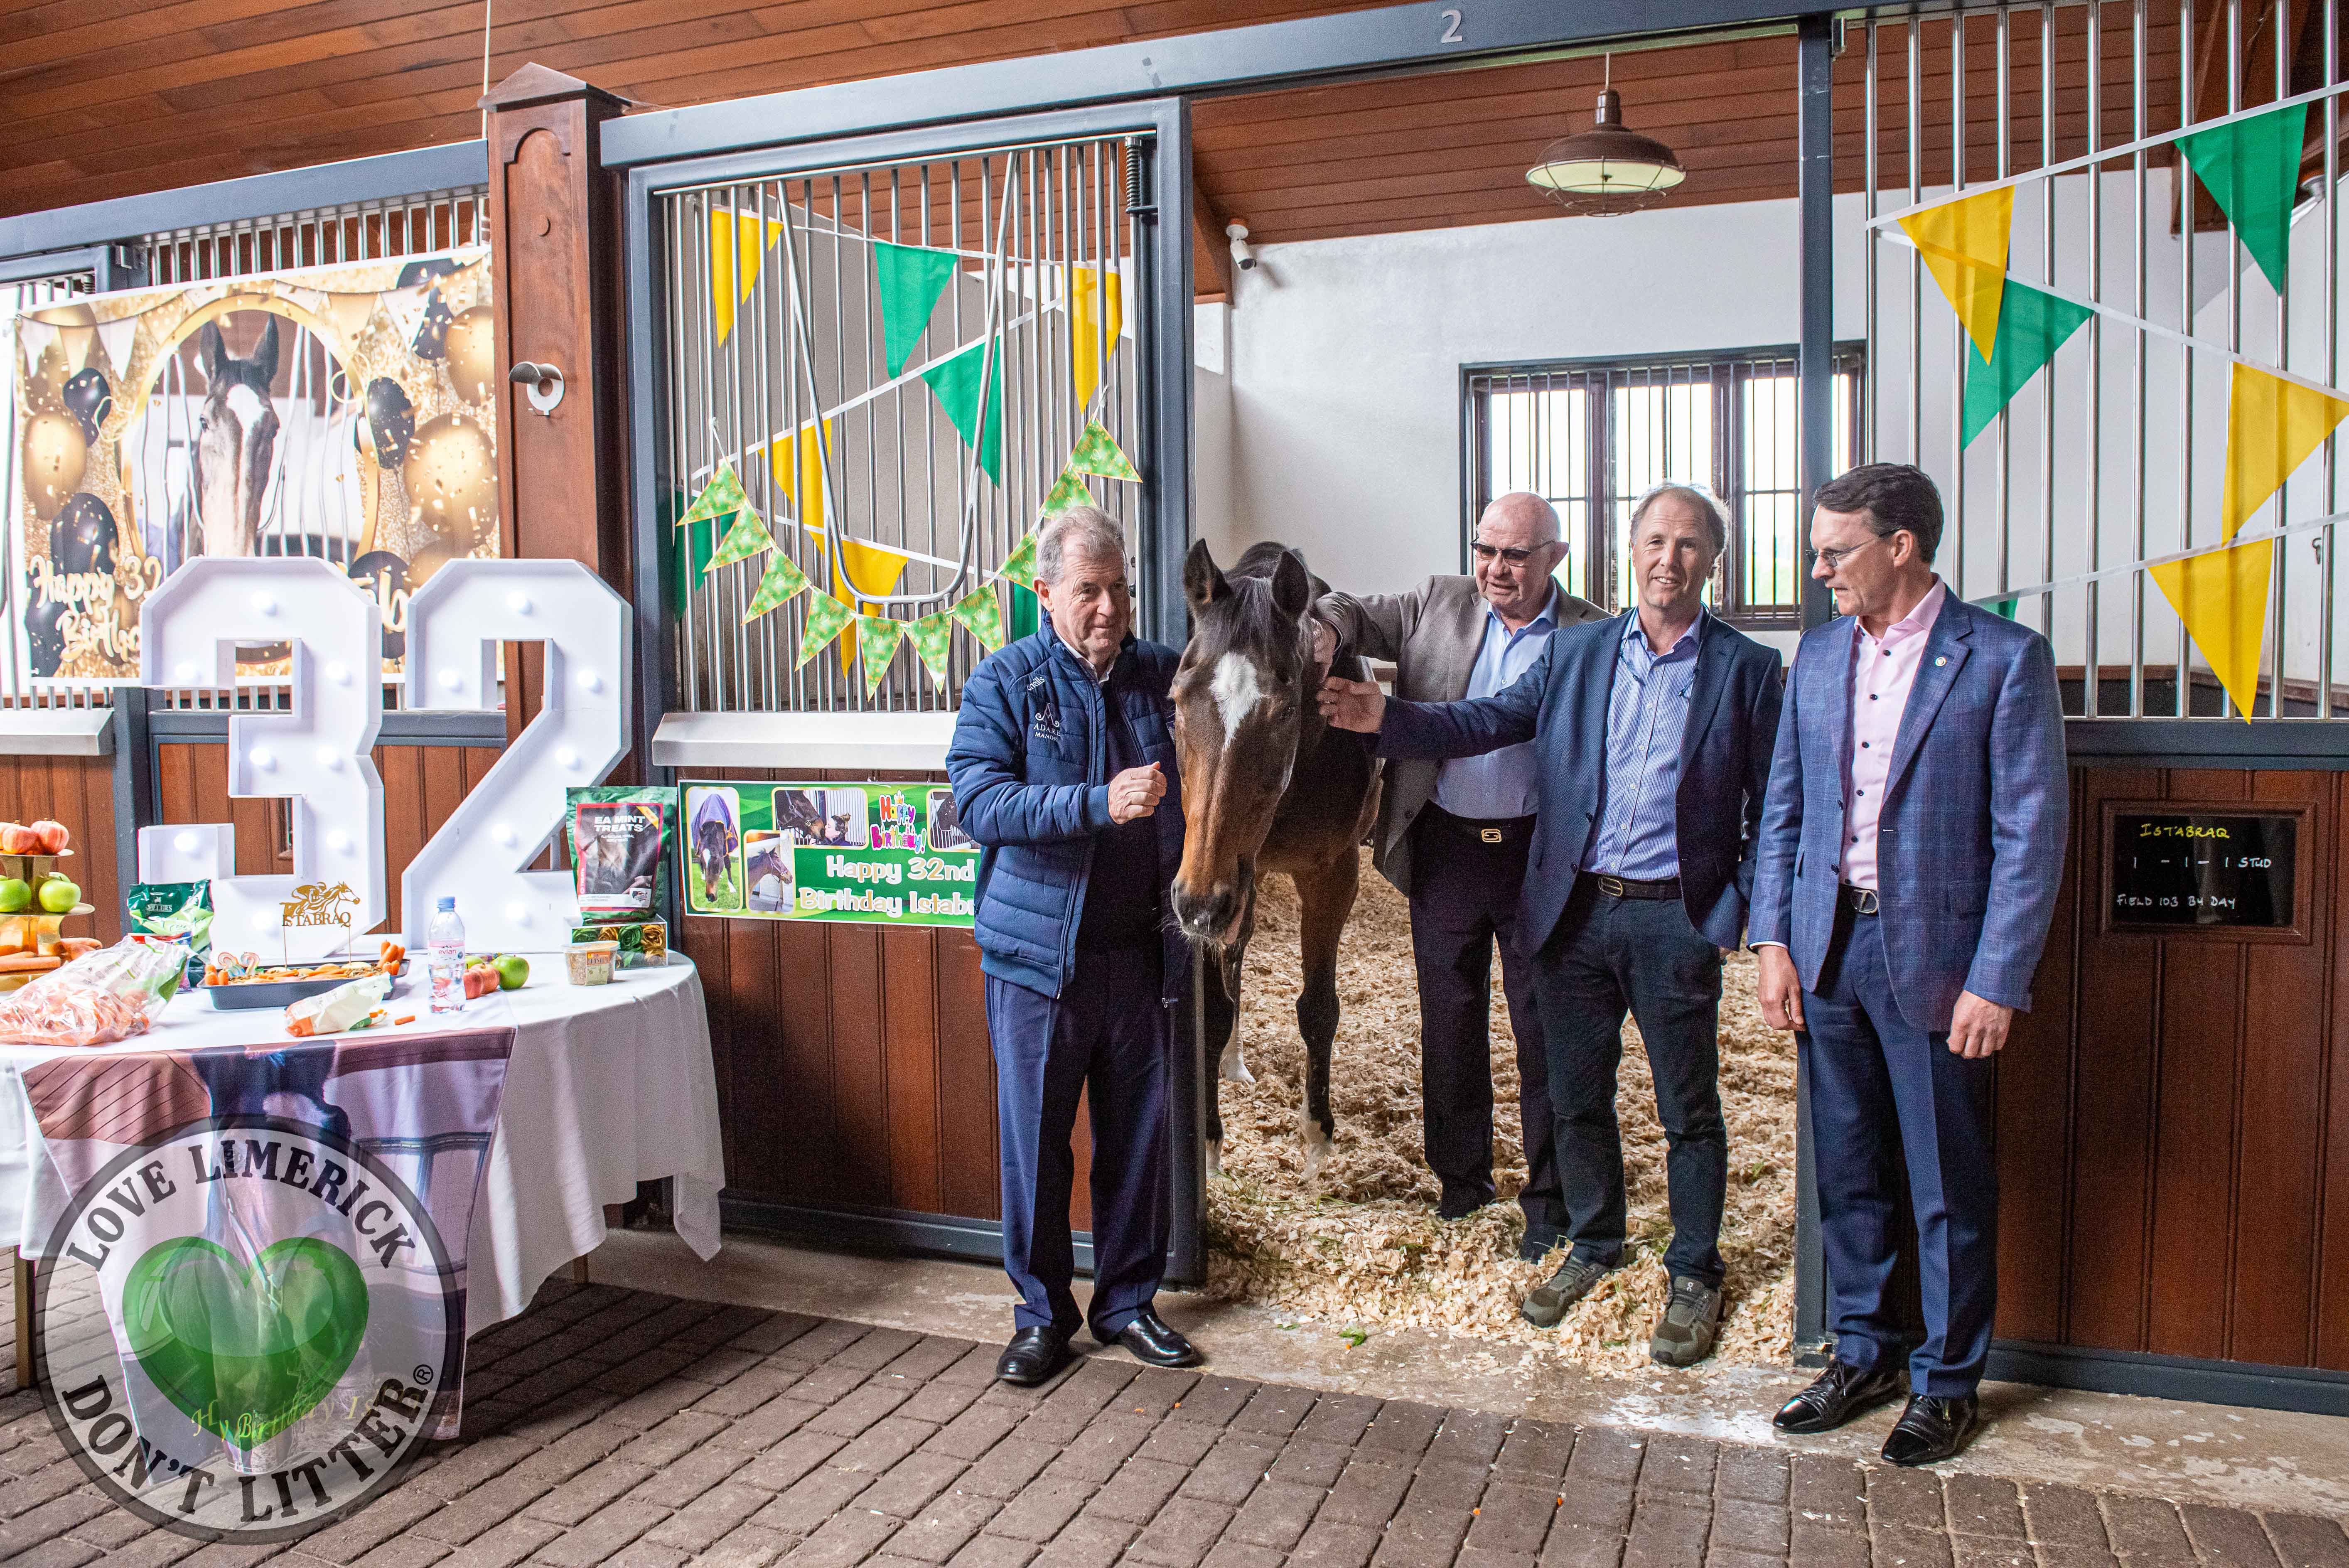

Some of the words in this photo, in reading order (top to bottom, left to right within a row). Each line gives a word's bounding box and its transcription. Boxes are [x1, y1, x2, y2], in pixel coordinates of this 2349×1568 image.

[1441, 9, 1462, 44] 2
[29, 555, 115, 615] Happy
[56, 609, 140, 662] Birth
[1033, 723, 1061, 736] ADARE
[1034, 732, 1057, 742] MANOR
[880, 795, 915, 824] Happy
[594, 816, 612, 824] EA
[614, 815, 646, 823] MINT
[593, 824, 644, 832] TREATS
[2140, 823, 2230, 838] ISTABRAQ
[826, 855, 902, 885] Happy
[907, 857, 975, 882] 32nd
[2237, 857, 2272, 868] STUD
[799, 887, 903, 918] Birthday
[909, 892, 975, 917] Istab
[2117, 894, 2152, 907] FIELD
[2160, 896, 2179, 907] 103
[2187, 895, 2204, 906] BY
[2210, 895, 2236, 909] DAY
[282, 912, 351, 928] ISTABRAQ
